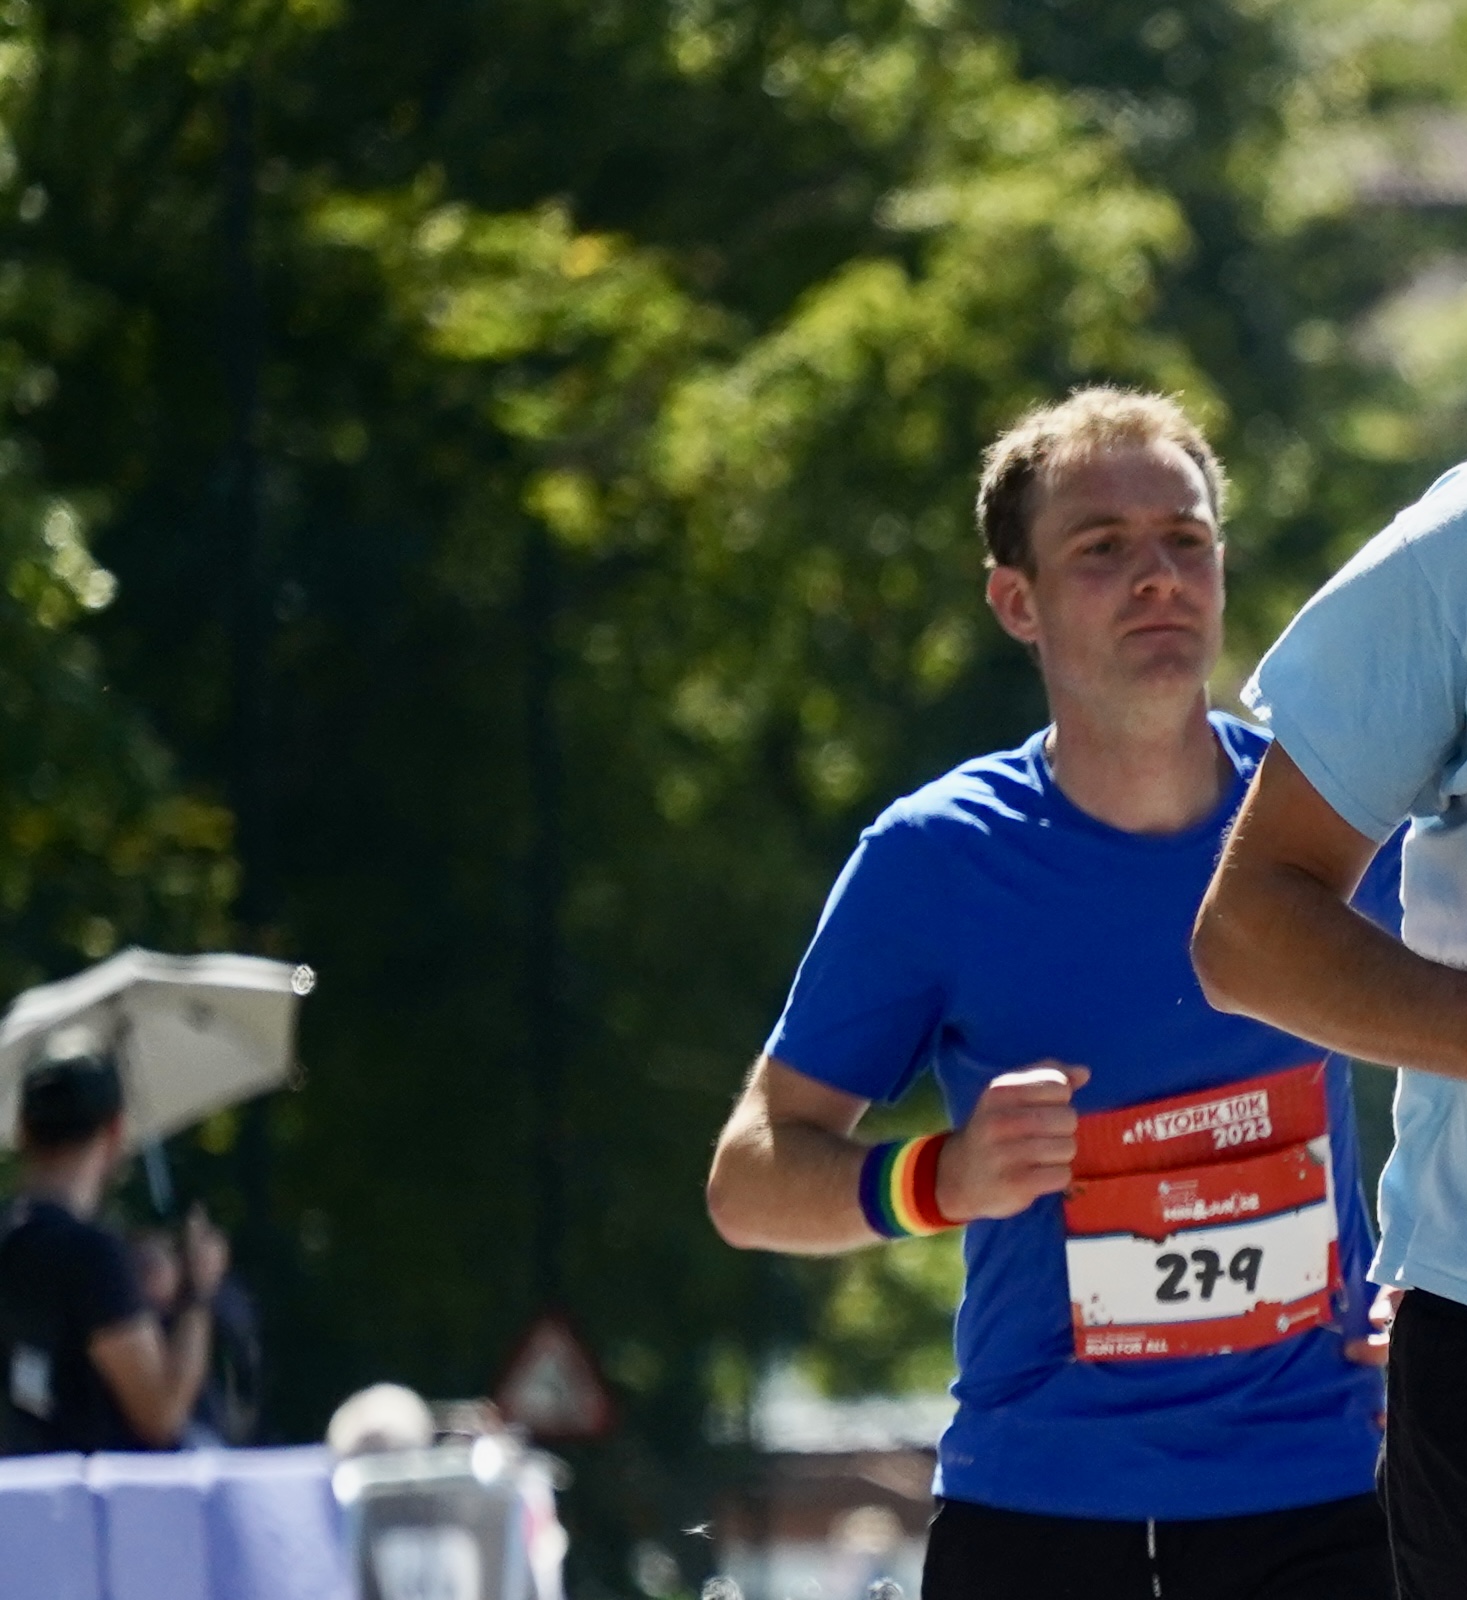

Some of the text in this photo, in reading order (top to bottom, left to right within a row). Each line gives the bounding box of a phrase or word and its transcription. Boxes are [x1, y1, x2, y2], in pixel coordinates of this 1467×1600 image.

[1158, 1094, 1264, 1138] YORK 10K
[1213, 1116, 1272, 1149] 2023
[1155, 1247, 1264, 1305] 279
